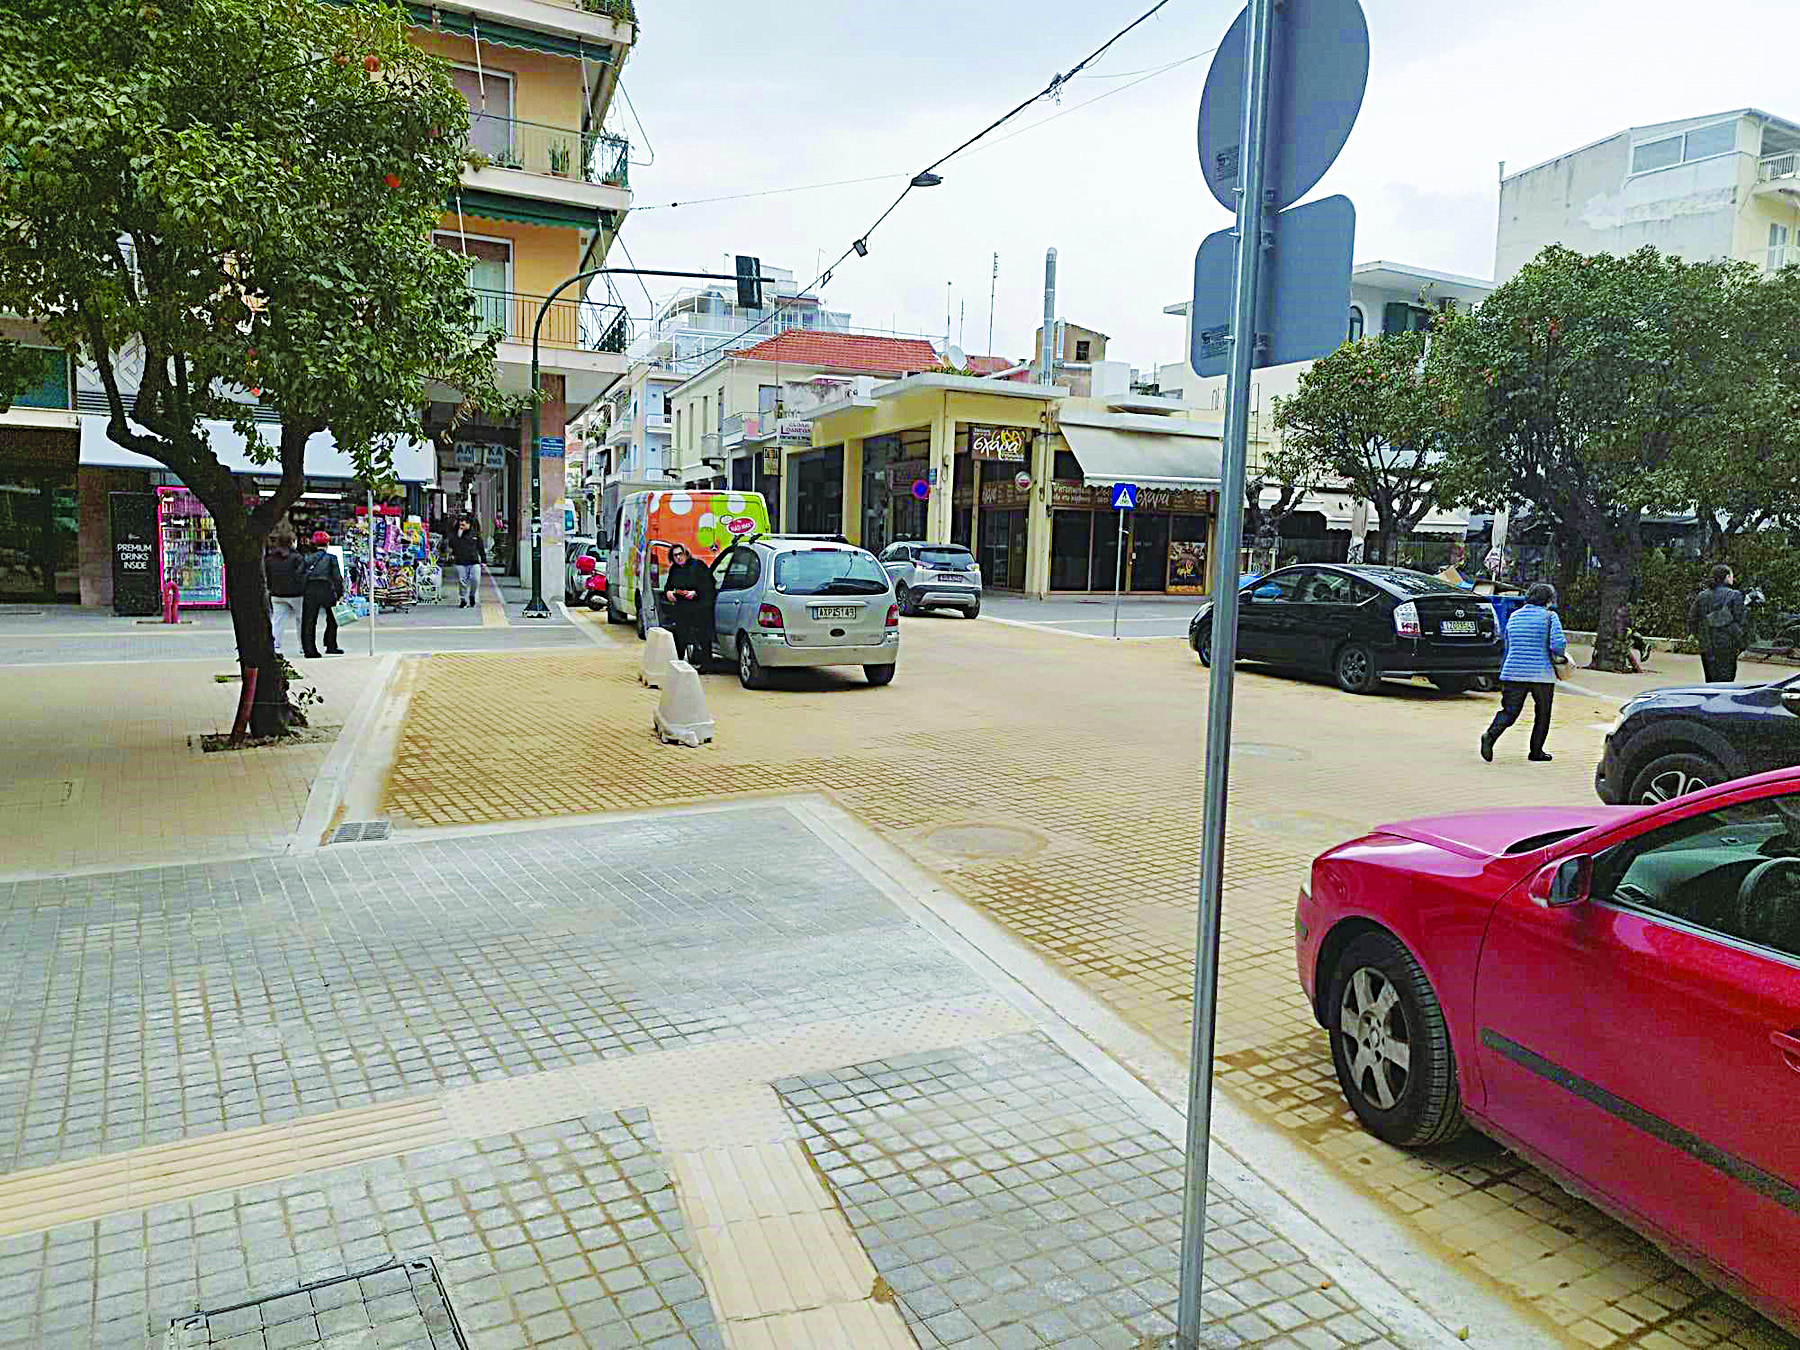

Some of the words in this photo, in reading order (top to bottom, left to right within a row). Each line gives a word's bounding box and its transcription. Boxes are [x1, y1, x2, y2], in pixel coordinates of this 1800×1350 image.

[117, 543, 151, 551] PREMIUM
[121, 552, 148, 560] DRINKS
[123, 561, 147, 569] INSIDE
